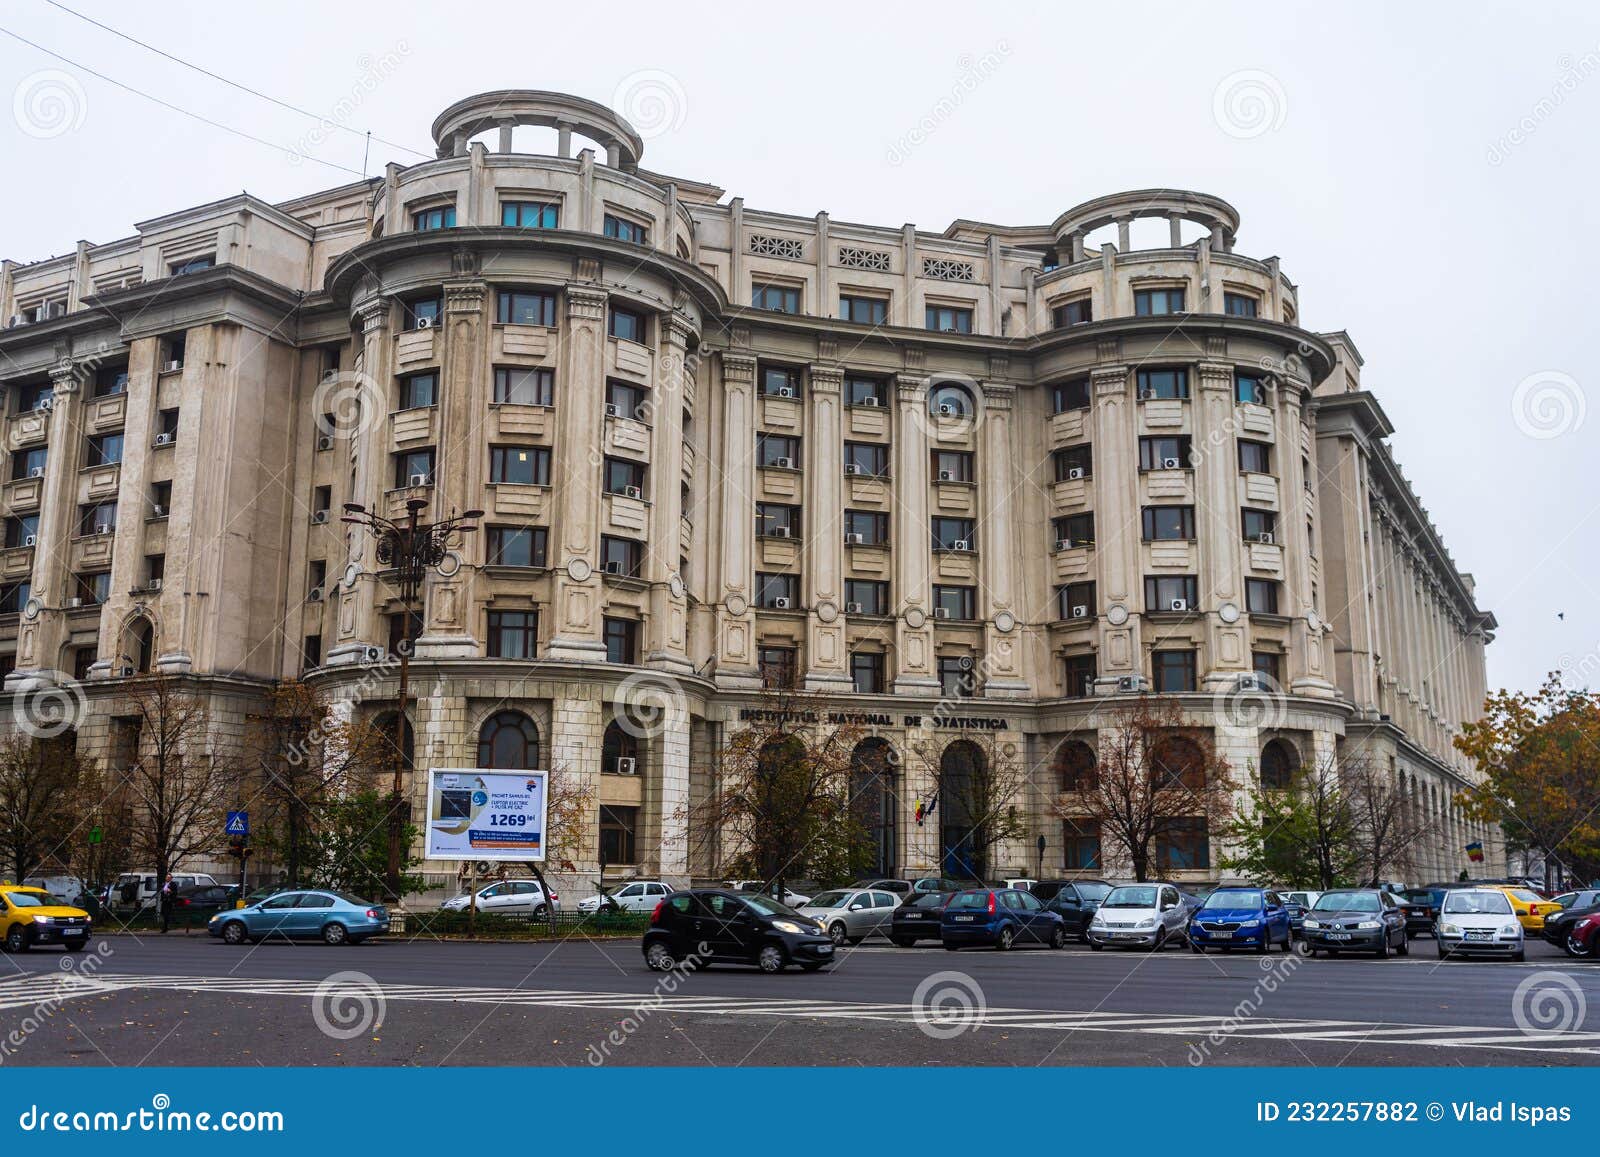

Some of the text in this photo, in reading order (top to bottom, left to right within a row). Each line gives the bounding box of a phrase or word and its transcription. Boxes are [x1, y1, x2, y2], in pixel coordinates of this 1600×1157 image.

[740, 709, 819, 723] INSTITUTUL
[904, 715, 922, 727] DE
[932, 716, 1008, 730] STATISTICA
[490, 814, 526, 826] 1269
